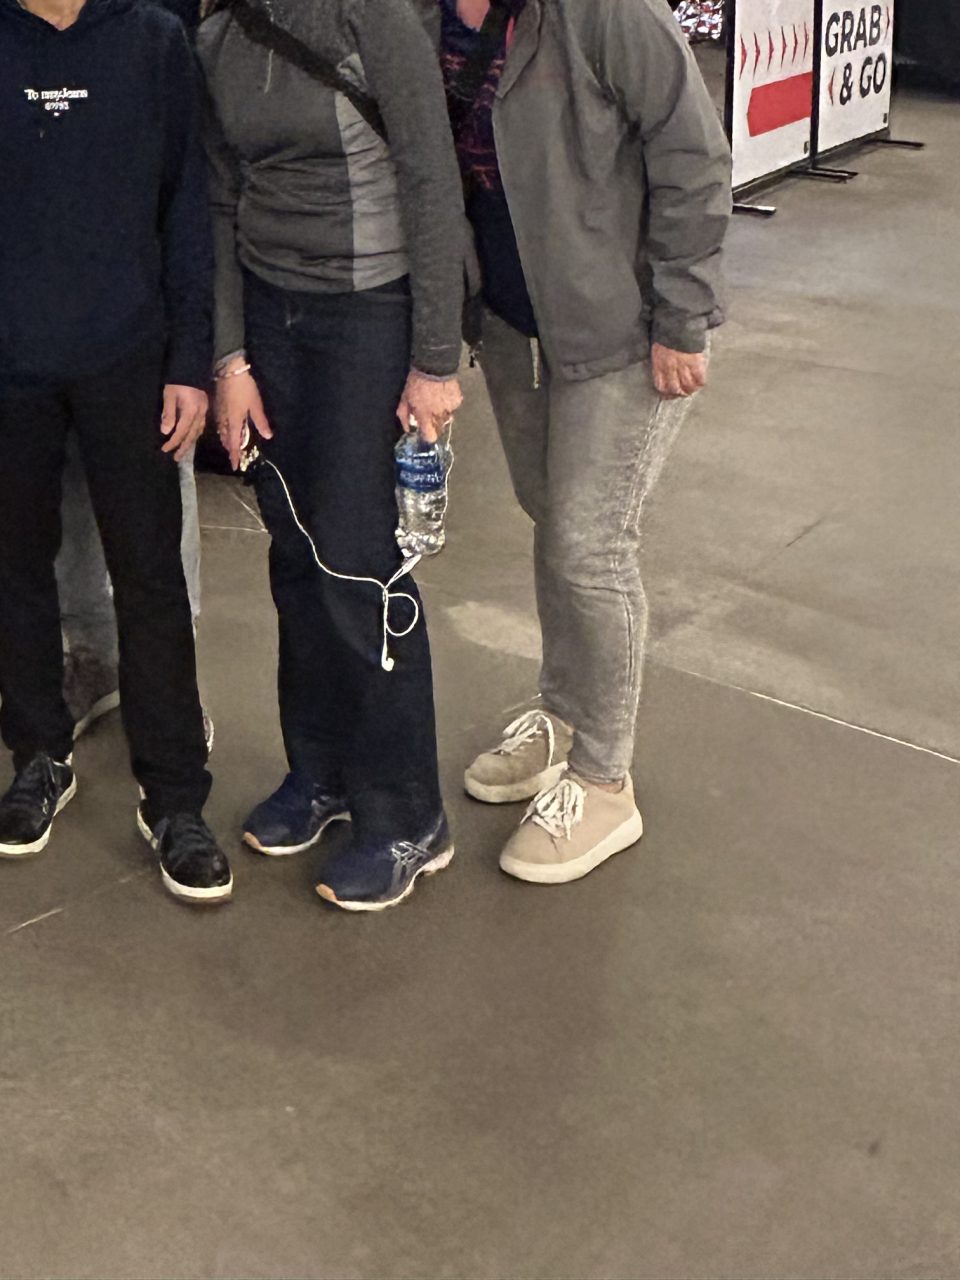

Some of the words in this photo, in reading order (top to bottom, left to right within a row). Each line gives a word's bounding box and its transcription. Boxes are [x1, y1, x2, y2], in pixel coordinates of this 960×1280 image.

[825, 4, 881, 57] GRAB
[839, 62, 853, 105] &
[859, 52, 887, 99] GO
